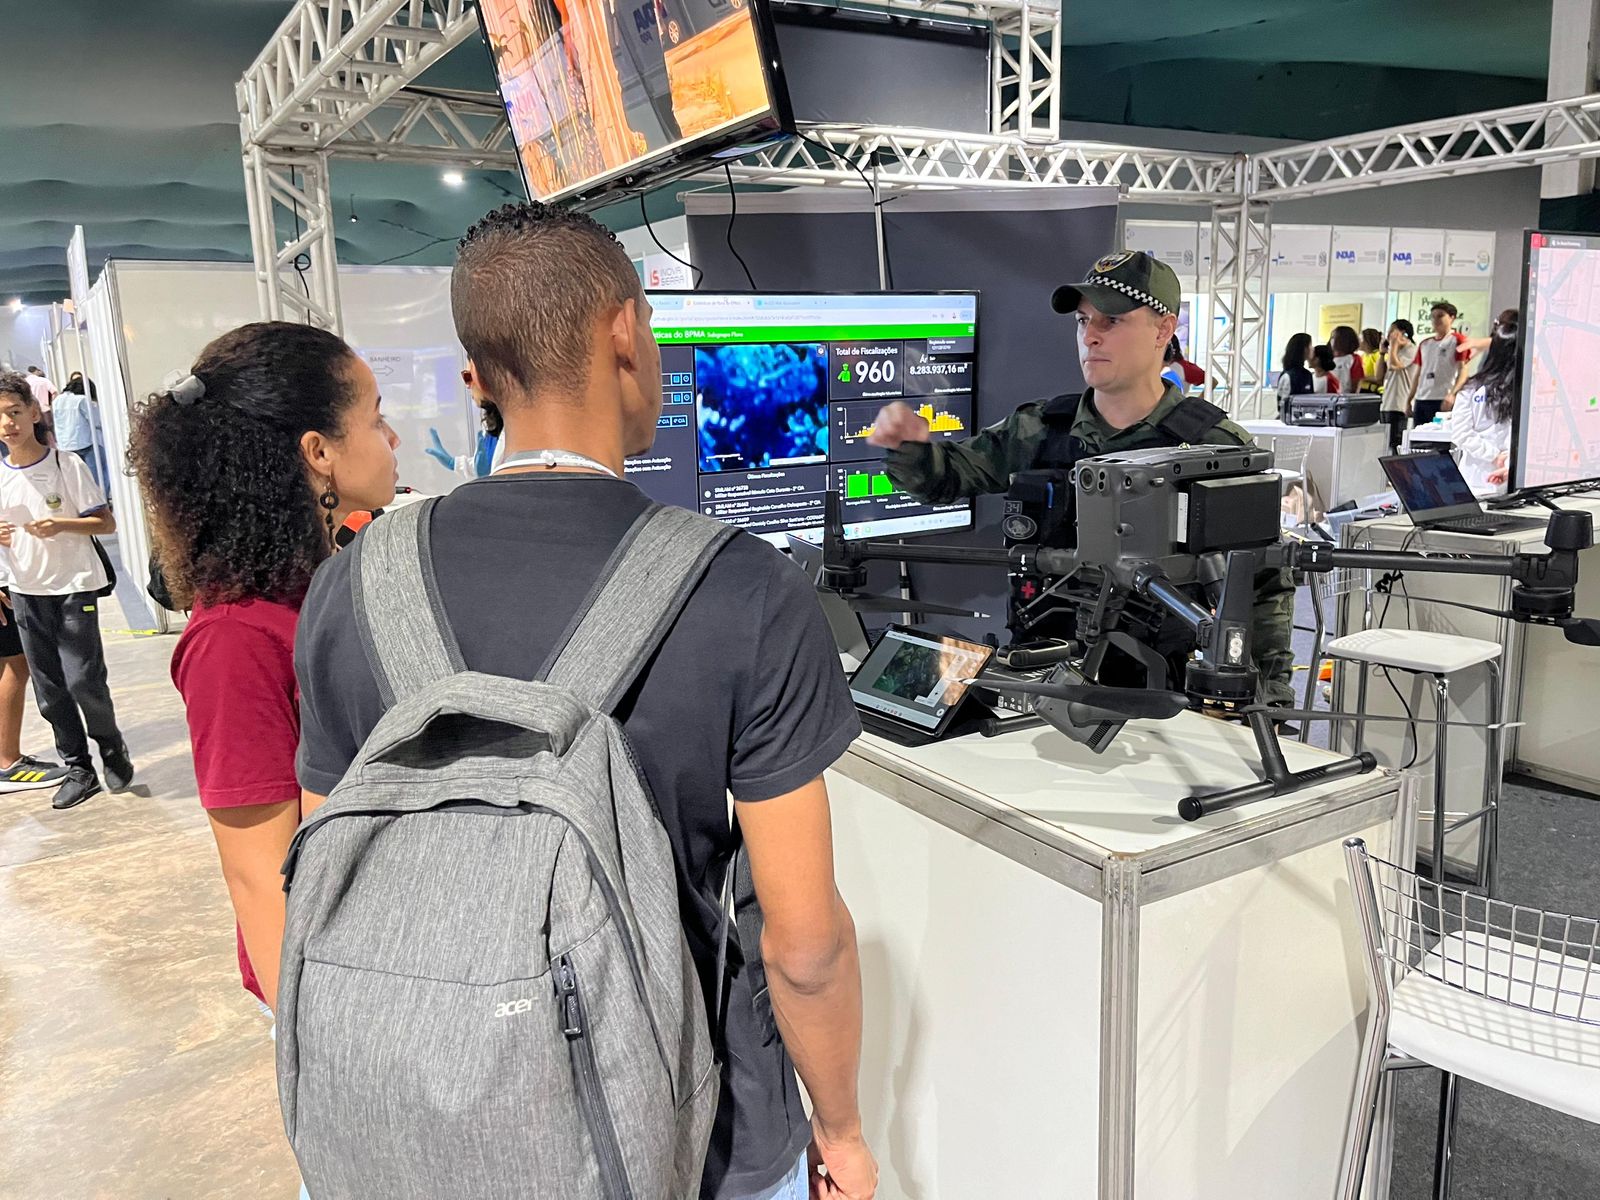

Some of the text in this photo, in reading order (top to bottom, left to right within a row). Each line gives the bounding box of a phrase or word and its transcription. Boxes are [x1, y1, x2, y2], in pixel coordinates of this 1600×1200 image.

[674, 330, 683, 338] do
[684, 330, 705, 338] BPMA
[836, 346, 898, 356] Total de Fiscalizações
[855, 359, 895, 383] 960
[1006, 502, 1020, 513] 34
[495, 997, 541, 1017] acer
